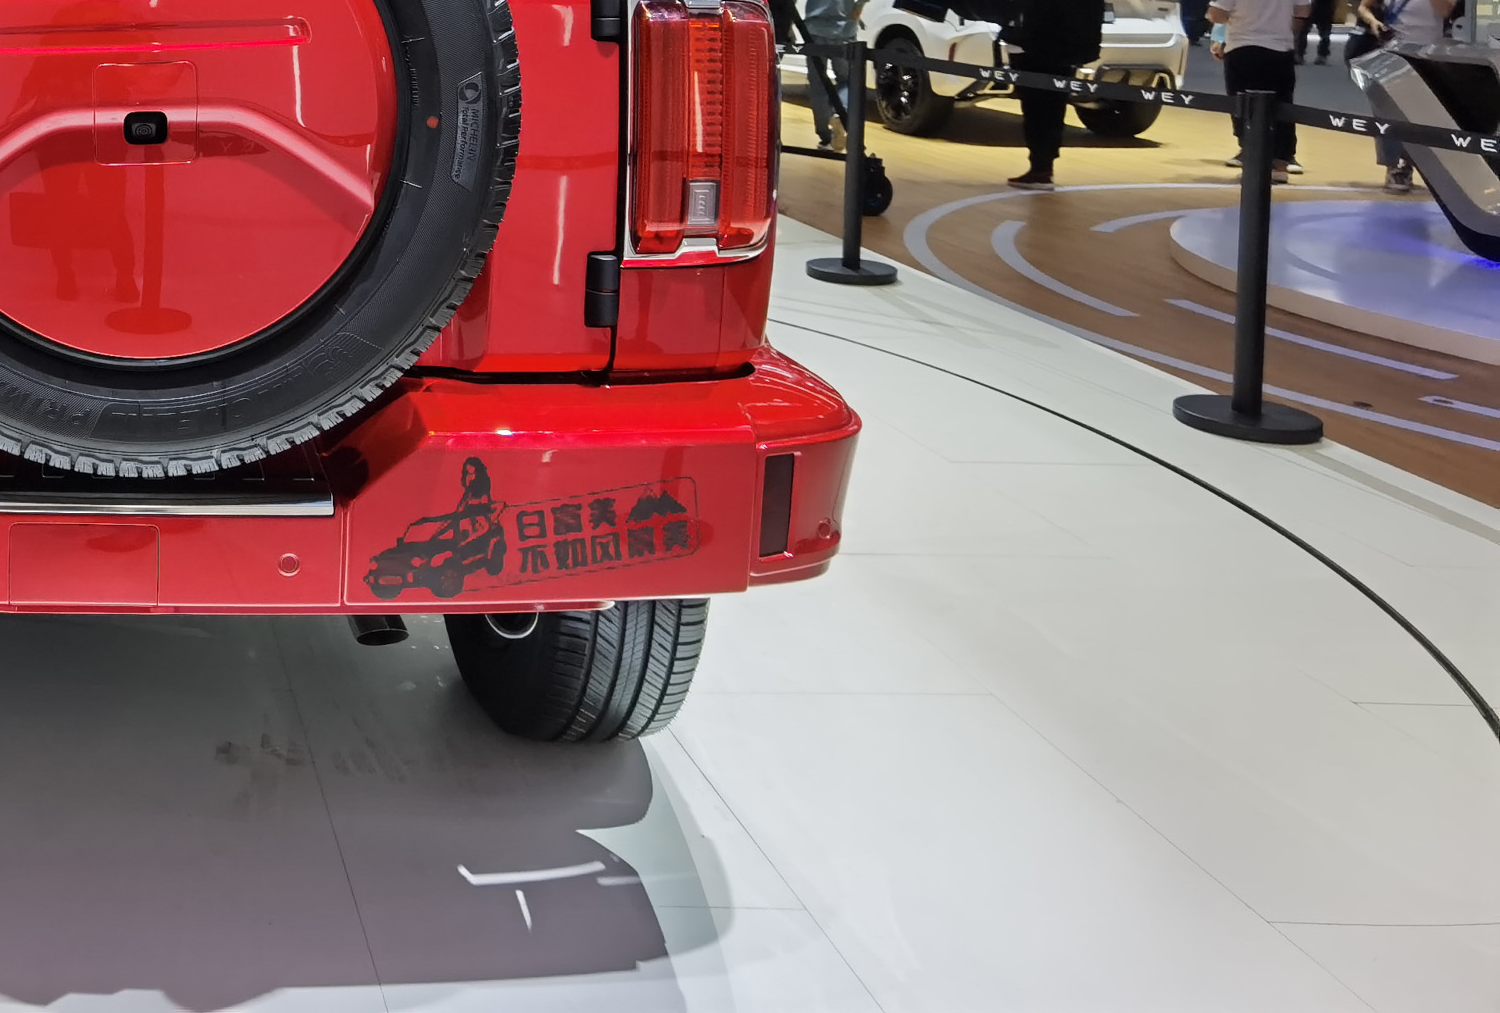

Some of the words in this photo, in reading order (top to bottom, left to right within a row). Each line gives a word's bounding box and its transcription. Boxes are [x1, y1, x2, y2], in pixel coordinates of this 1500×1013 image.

[980, 68, 1020, 82] WEY
[1053, 78, 1098, 93] WEY
[1141, 89, 1194, 105] WEY
[467, 108, 480, 162] MICHELIN
[1329, 114, 1392, 135] WEY
[454, 126, 469, 179] Performance
